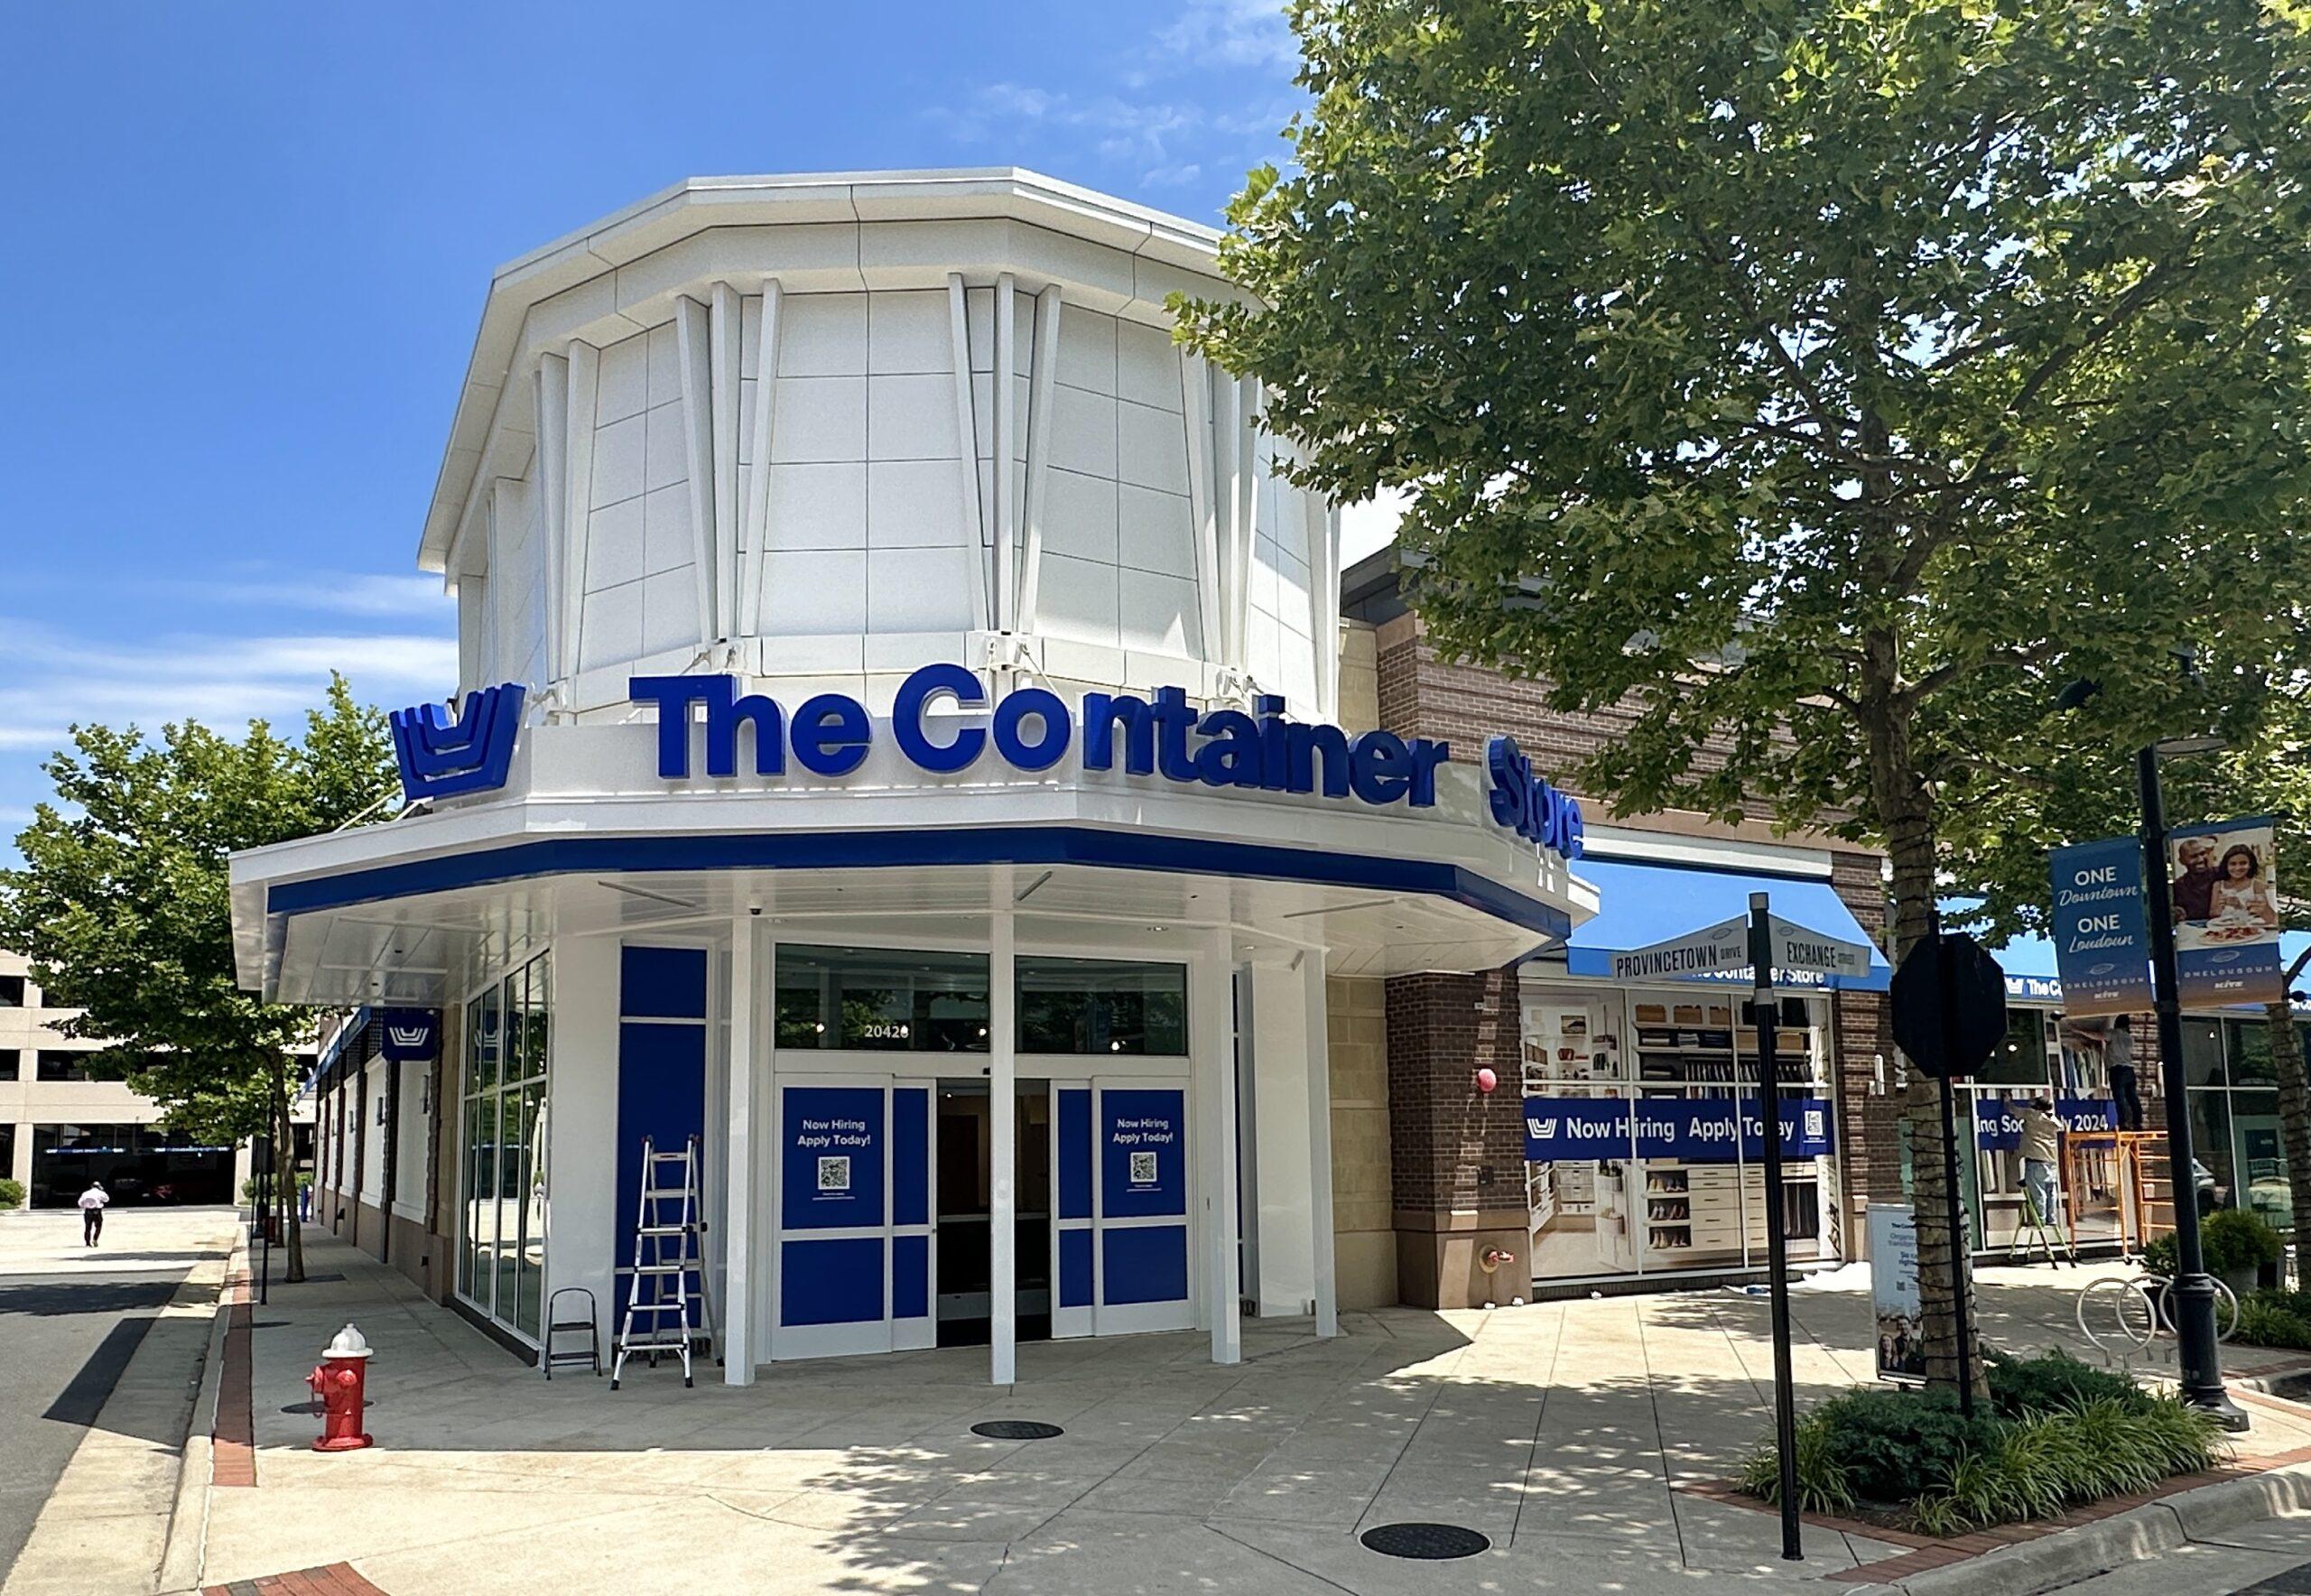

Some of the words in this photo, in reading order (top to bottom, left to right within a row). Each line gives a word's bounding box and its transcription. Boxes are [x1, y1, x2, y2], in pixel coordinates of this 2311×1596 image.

[629, 673, 873, 779] The
[893, 663, 1450, 808] Container
[1490, 736, 1584, 860] Store
[2074, 866, 2117, 886] ONE
[2057, 886, 2138, 906] Downtown
[2077, 914, 2120, 933] ONE
[2068, 933, 2134, 953] Loudoun
[1616, 944, 1717, 979] PROVINCETOWN
[1720, 946, 1741, 960] DRIVE
[1787, 941, 1836, 968] EXCHANGE
[1787, 967, 1824, 983] Store
[2027, 979, 2049, 996] The
[803, 1119, 829, 1129] Now
[831, 1119, 866, 1132] Hiring
[1118, 1118, 1138, 1128] Now
[1140, 1118, 1169, 1130] Hiring
[1566, 1118, 1610, 1138] Now
[1615, 1117, 1675, 1142] Hiring
[1688, 1117, 1737, 1142] Apply
[1742, 1117, 1795, 1142] Toay
[2074, 1114, 2109, 1131] 2024
[797, 1135, 831, 1147] Apply
[832, 1135, 870, 1147] Today!
[1112, 1132, 1140, 1145] Apply
[1142, 1132, 1174, 1144] Today!
